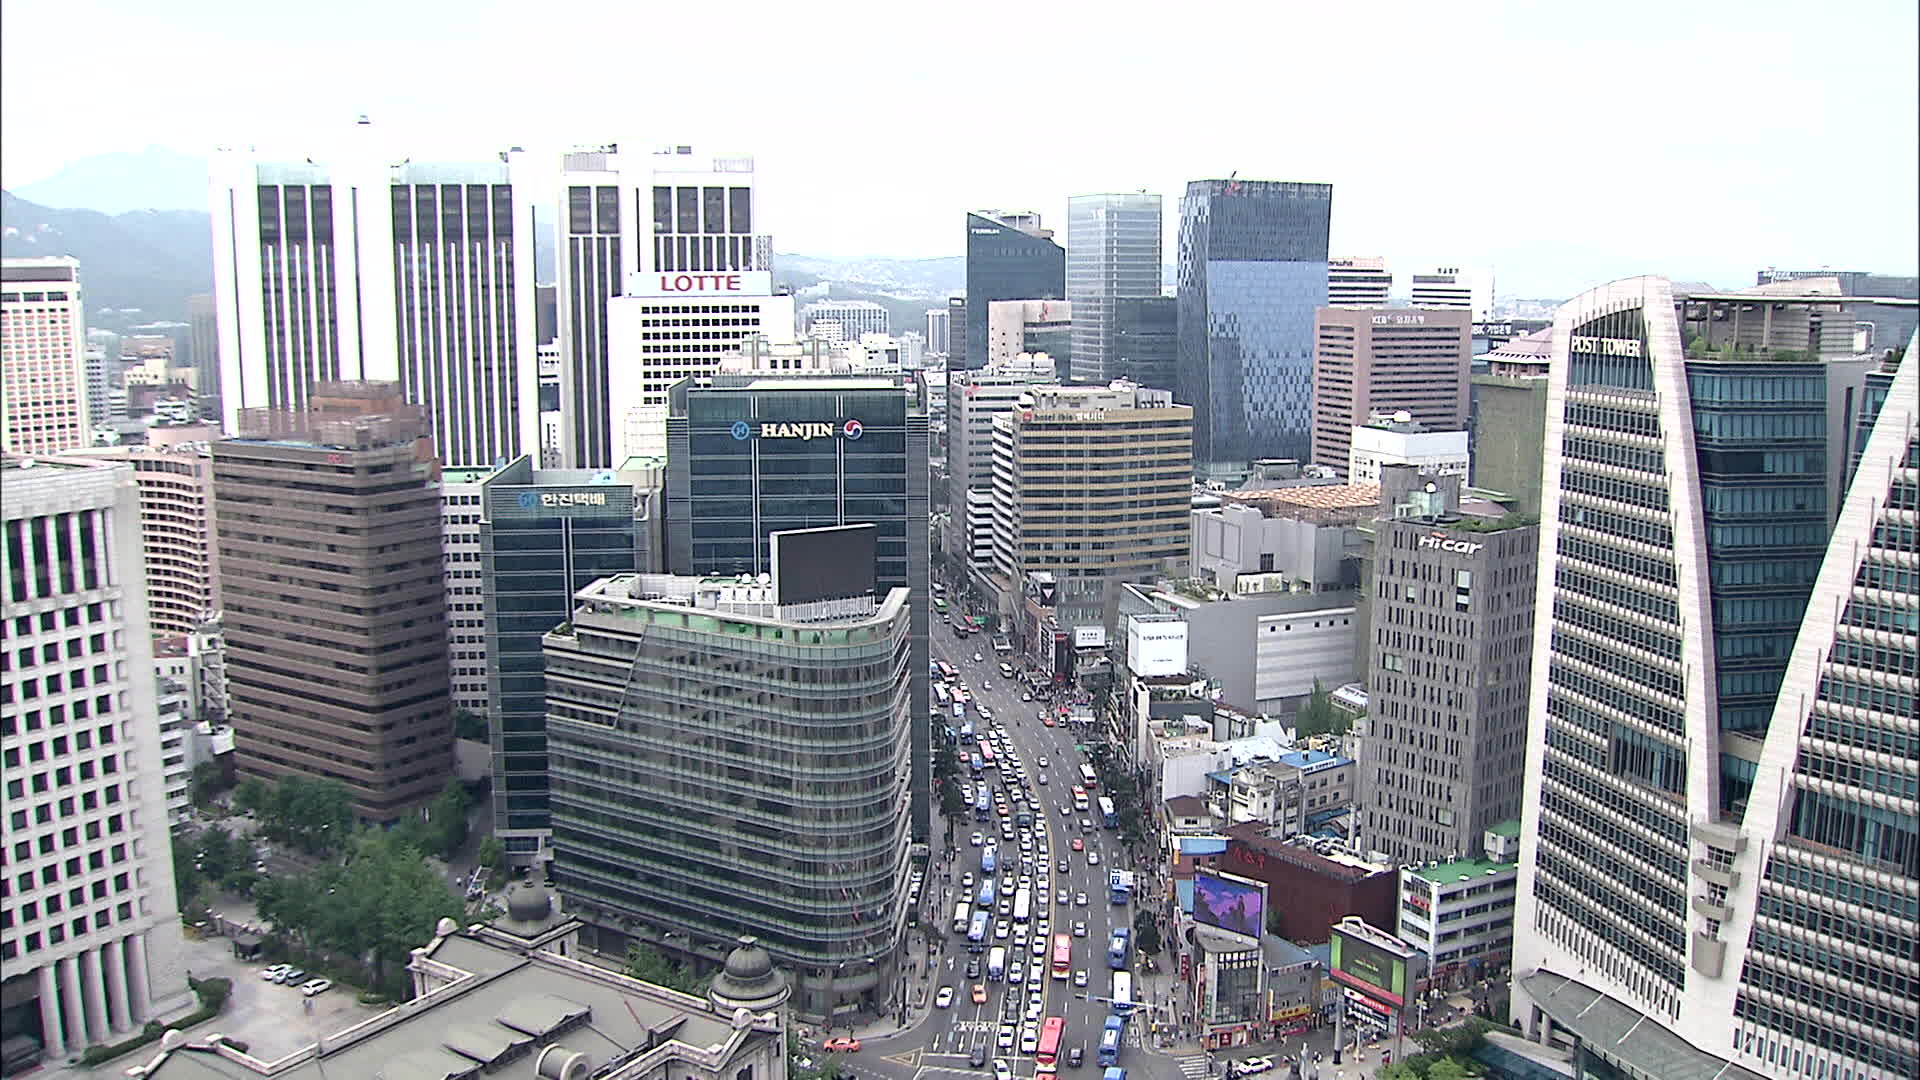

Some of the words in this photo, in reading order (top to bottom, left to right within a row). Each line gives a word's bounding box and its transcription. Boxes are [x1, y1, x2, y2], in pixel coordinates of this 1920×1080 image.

[661, 275, 741, 291] LOTTE
[1571, 335, 1599, 354] POST
[1600, 337, 1640, 358] TOWER
[760, 423, 834, 441] HANJIN
[541, 492, 606, 507] 한진택배
[1418, 532, 1483, 555] Hicar
